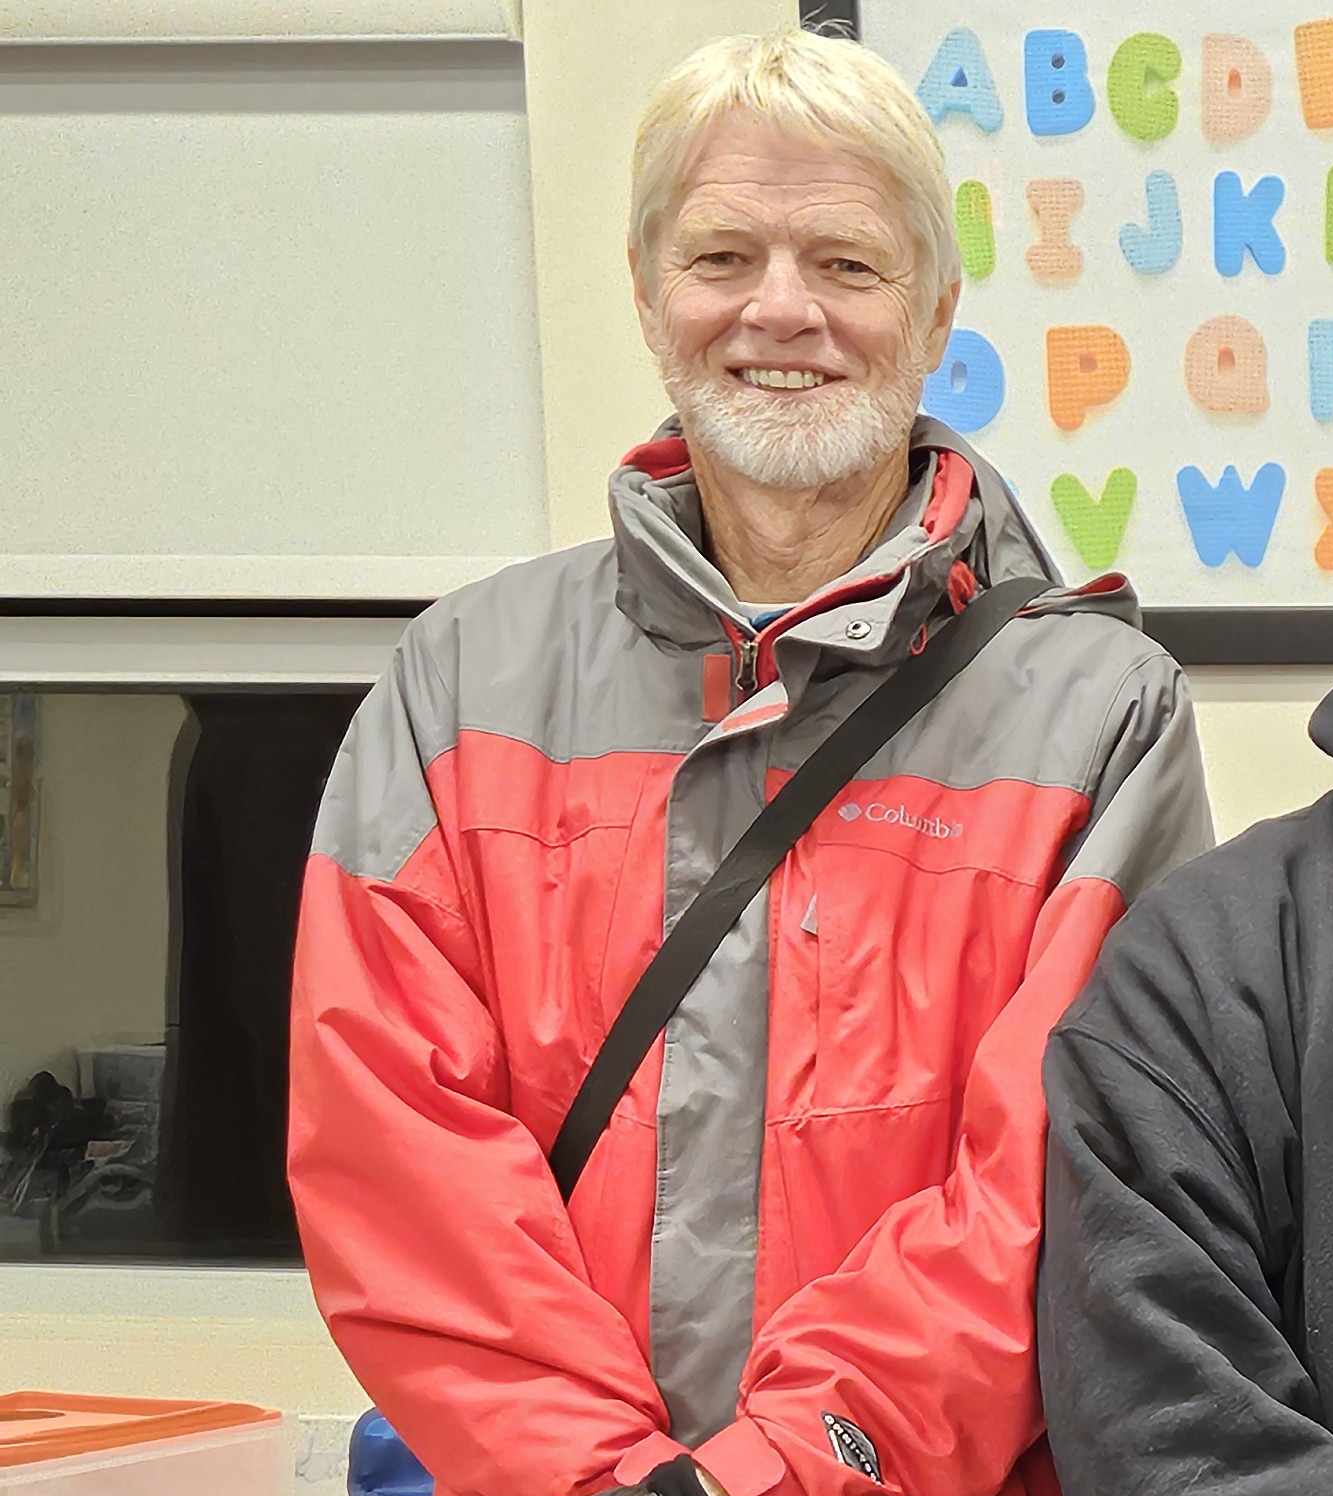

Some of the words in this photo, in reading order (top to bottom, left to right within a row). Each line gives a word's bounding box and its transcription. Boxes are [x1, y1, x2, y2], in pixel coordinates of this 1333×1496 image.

[916, 26, 1003, 133] A
[1024, 29, 1096, 136] B
[1107, 32, 1182, 140] C
[1201, 32, 1272, 140] D
[1026, 179, 1084, 280] I
[1119, 170, 1182, 275] J
[1214, 171, 1286, 277] K
[922, 328, 1005, 432] O
[1047, 325, 1131, 431] P
[1185, 314, 1269, 414] Q
[1051, 467, 1137, 568] V
[1176, 462, 1286, 567] W
